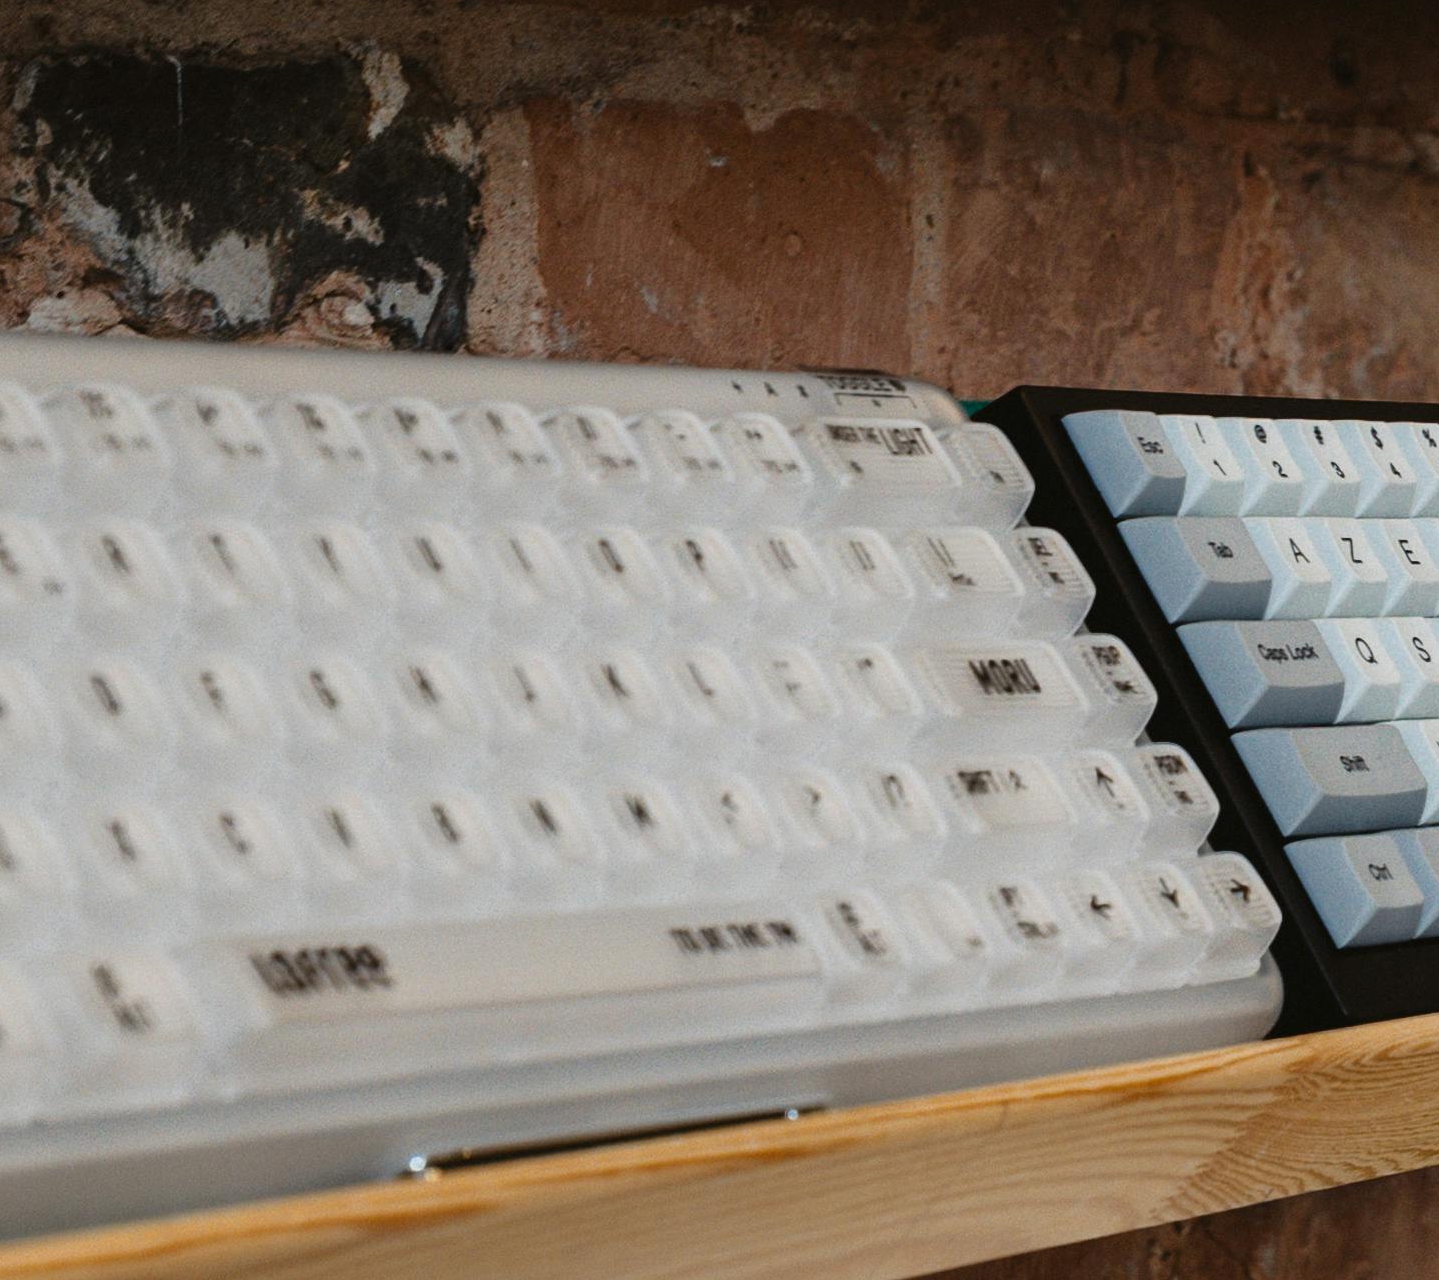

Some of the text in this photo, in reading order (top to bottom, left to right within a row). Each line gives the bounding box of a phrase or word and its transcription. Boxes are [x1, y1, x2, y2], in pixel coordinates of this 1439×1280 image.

[1137, 436, 1164, 454] Esc
[1212, 459, 1227, 476] 1
[1271, 460, 1289, 479] 2
[1330, 461, 1346, 479] 3
[1207, 541, 1234, 559] Tab
[1288, 538, 1310, 563] A
[1340, 536, 1363, 565] Z
[1398, 538, 1421, 566] E
[1257, 643, 1318, 662] Caps Lock
[1354, 636, 1378, 664] Q
[1411, 636, 1432, 663] S
[1339, 755, 1369, 773] Shift
[1367, 863, 1393, 882] Ctrl
